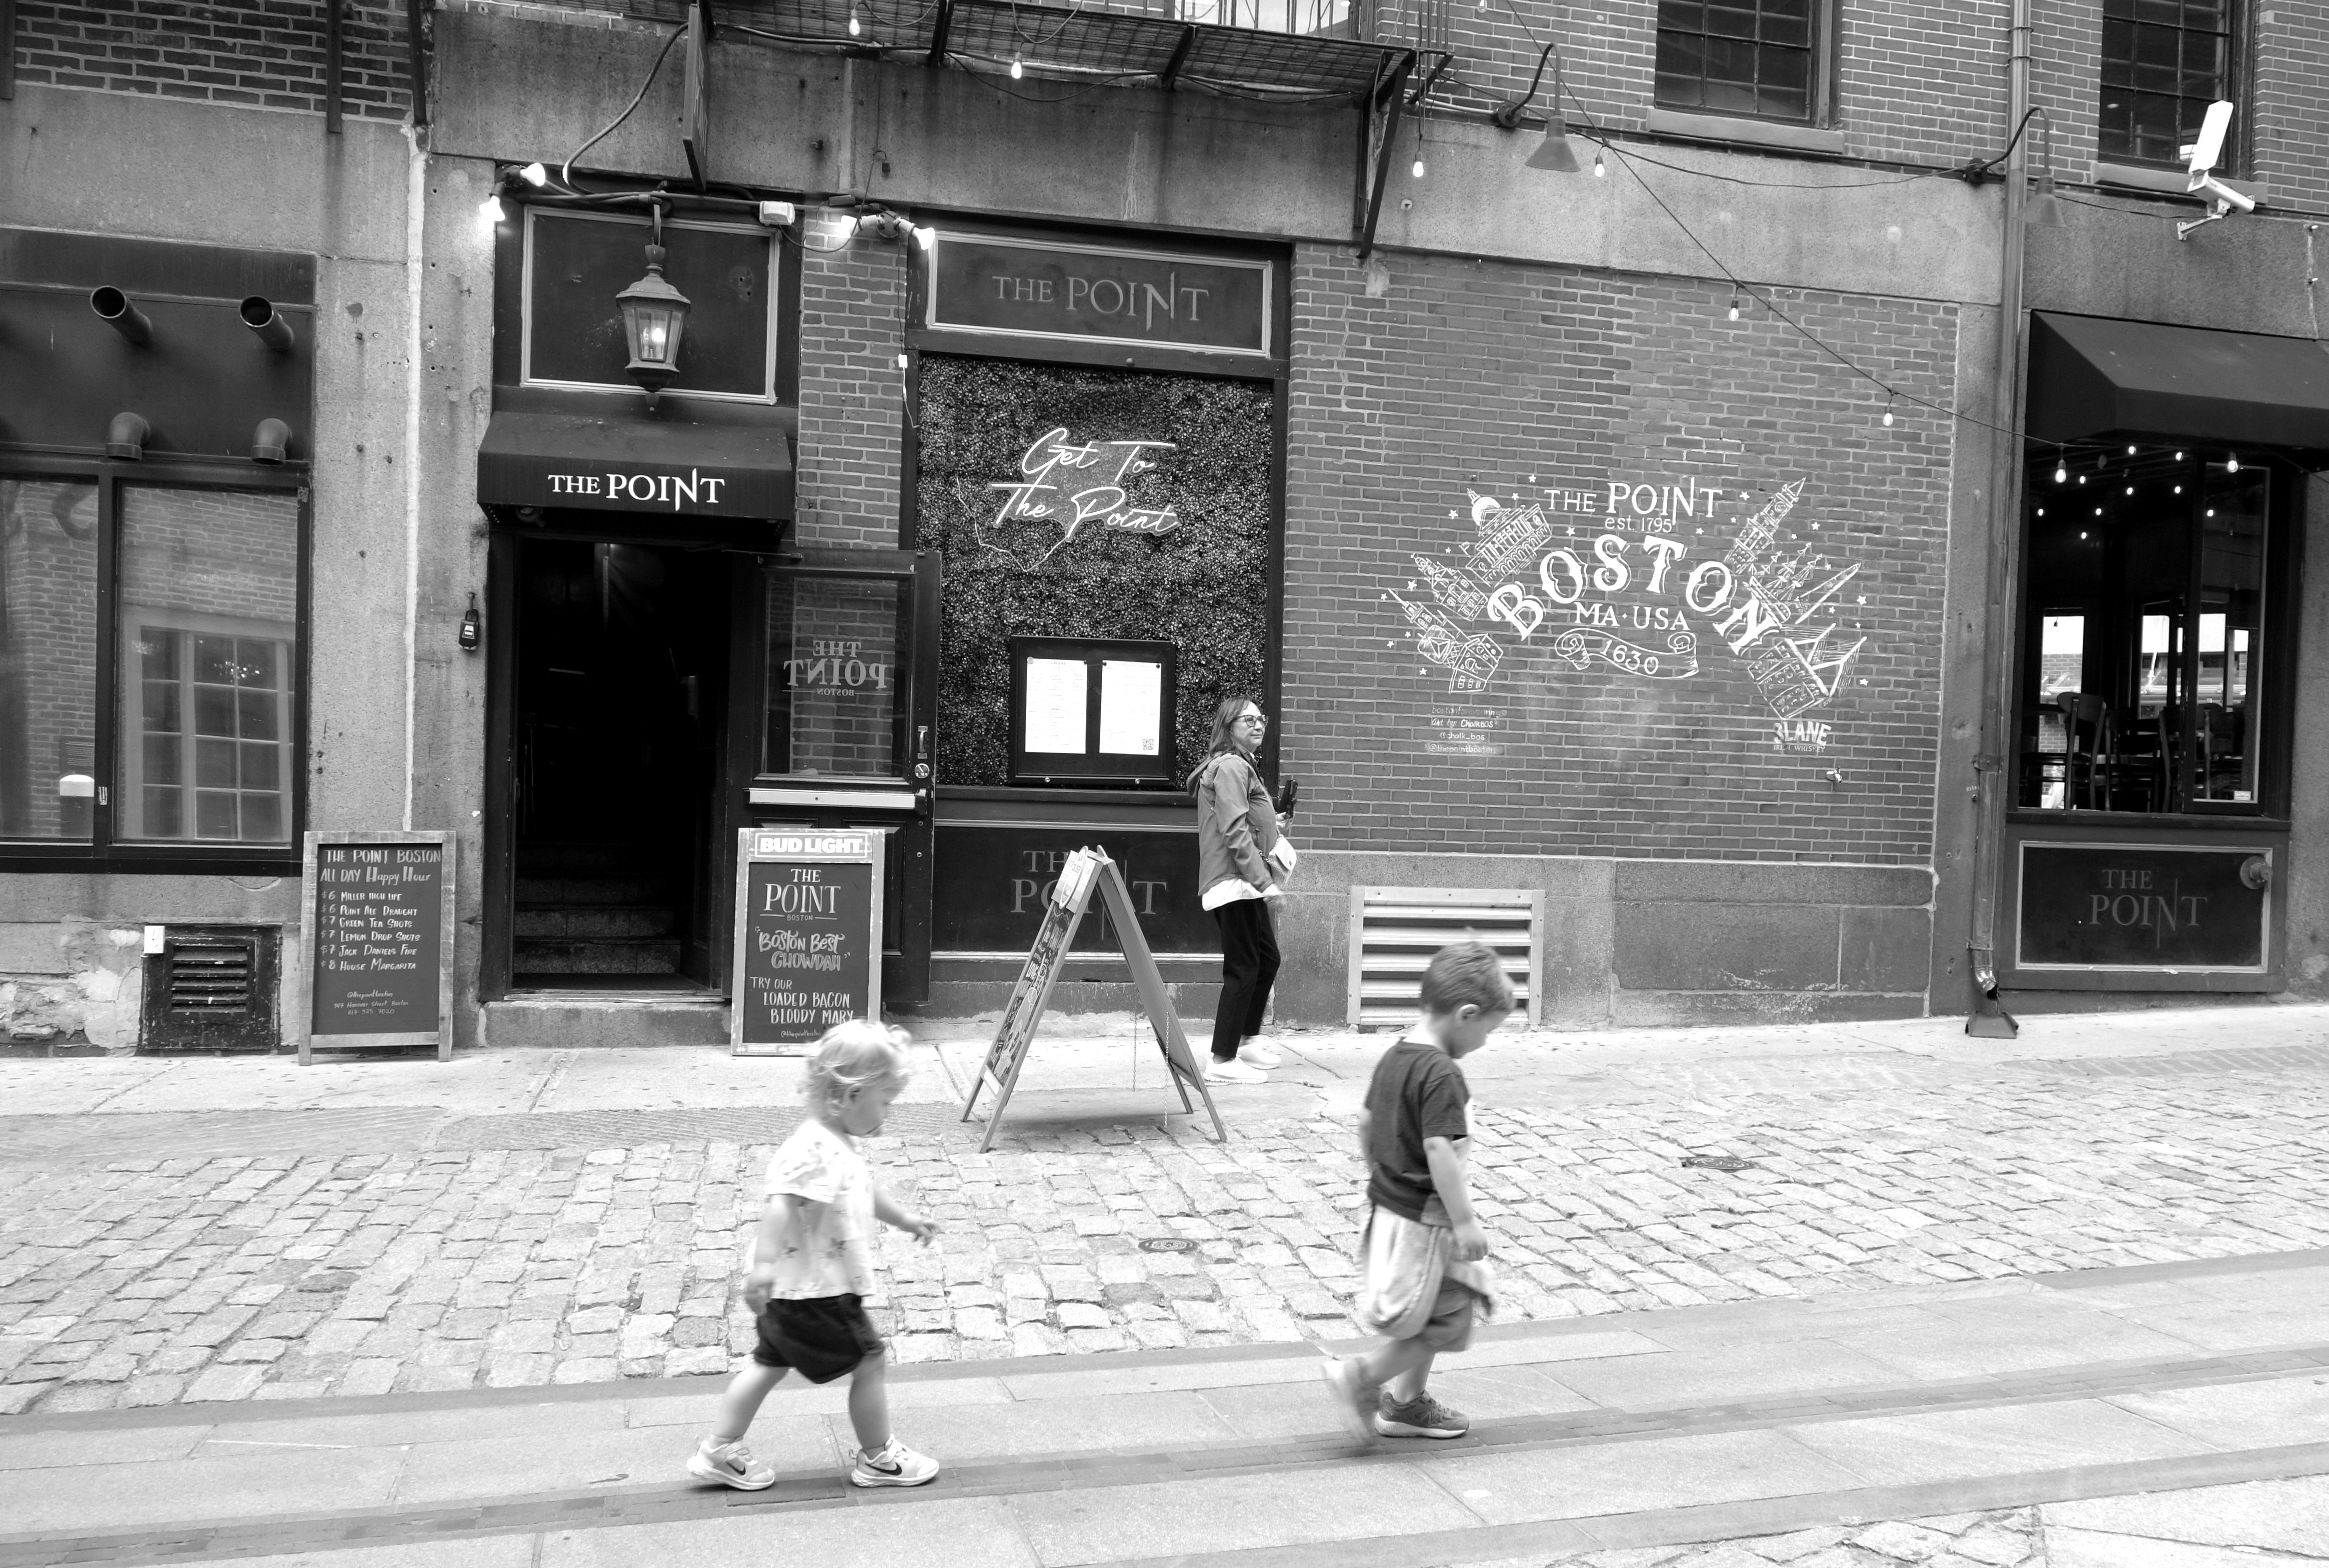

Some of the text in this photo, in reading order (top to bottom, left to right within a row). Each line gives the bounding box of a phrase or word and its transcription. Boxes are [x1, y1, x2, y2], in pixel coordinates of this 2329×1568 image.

[992, 272, 1209, 331] THE POINT
[1022, 427, 1175, 487] Get To
[548, 468, 725, 511] THE POINT
[991, 484, 1178, 538] The Point
[1544, 477, 1723, 525] THE POINT
[1605, 515, 1673, 533] est. 1795
[1487, 534, 1780, 655] BOSTON
[1574, 602, 1691, 631] MA USA
[1601, 639, 1659, 675] 1630
[760, 837, 863, 853] BUD LIGHT
[324, 850, 441, 864] THE POINT BOSTON
[1023, 850, 1069, 872] TH
[340, 869, 361, 882] DAY
[365, 866, 399, 886] Happy
[402, 865, 431, 882] Hour
[790, 868, 821, 883] THE
[2101, 869, 2153, 889] THE
[388, 892, 402, 901] LIFE
[763, 883, 841, 914] POINT
[2089, 877, 2208, 949] POINT
[750, 976, 792, 990] TRY OUR
[764, 991, 850, 1009] LOADED BACON
[770, 1008, 853, 1024] BLOODY MARY
